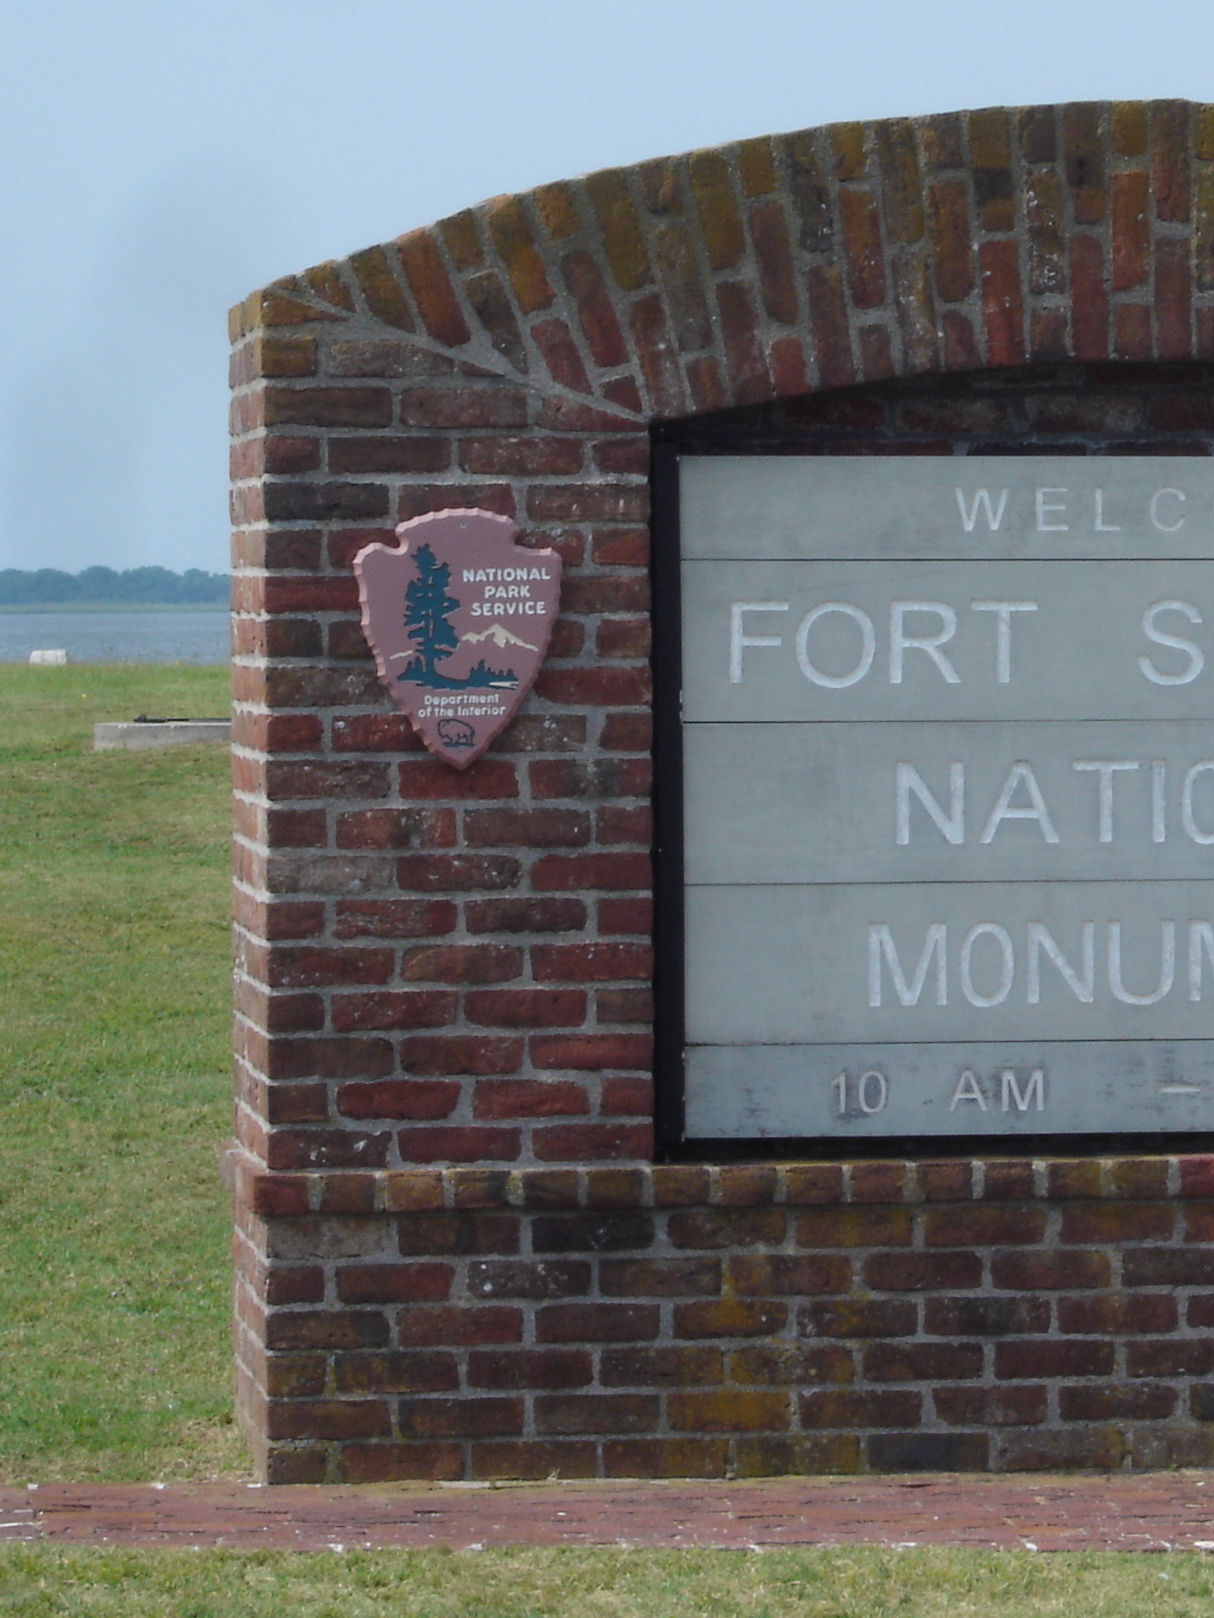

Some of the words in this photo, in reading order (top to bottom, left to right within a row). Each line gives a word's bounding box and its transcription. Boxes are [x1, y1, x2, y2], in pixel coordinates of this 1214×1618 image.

[462, 568, 550, 582] NATIONAL
[484, 586, 531, 598] PARK
[471, 601, 546, 616] SERVICE
[729, 601, 1038, 688] FORT
[424, 695, 499, 706] Department
[418, 707, 431, 718] of
[434, 706, 453, 717] the
[458, 705, 506, 716] Interior
[831, 1071, 888, 1113] 10
[949, 1069, 1045, 1112] AM
